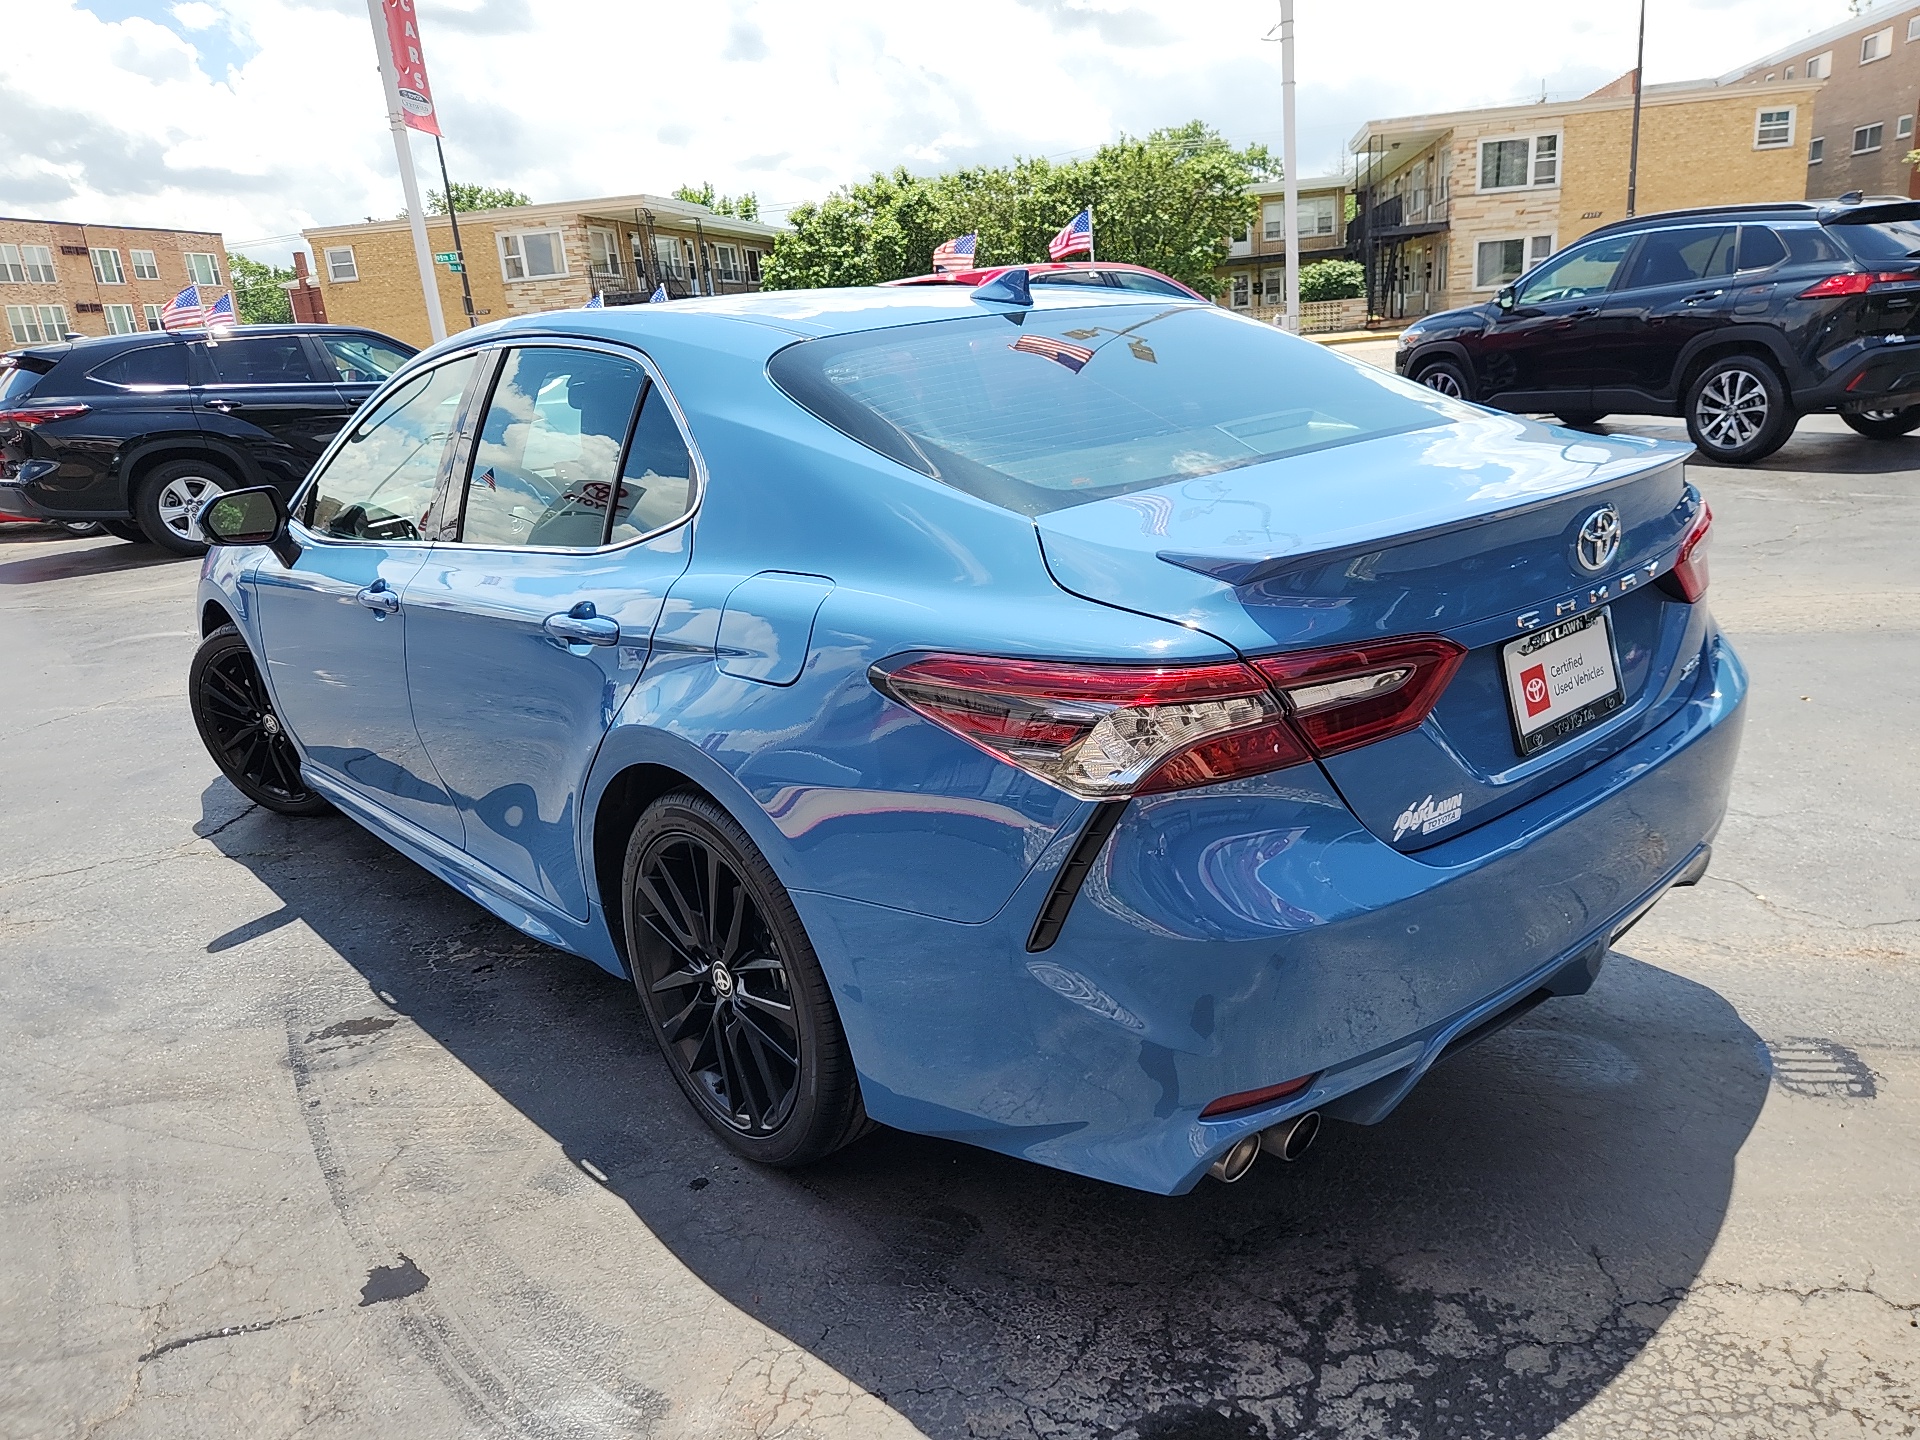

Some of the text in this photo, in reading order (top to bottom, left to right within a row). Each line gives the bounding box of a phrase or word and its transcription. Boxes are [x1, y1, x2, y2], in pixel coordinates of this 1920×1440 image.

[1516, 560, 1659, 629] CAMRY
[1555, 617, 1584, 640] LAWN
[1550, 653, 1584, 678] Certified
[1554, 665, 1605, 696] Used Vehicles
[1554, 708, 1596, 735] TOYOTA
[1427, 810, 1457, 830] TOYOTA
